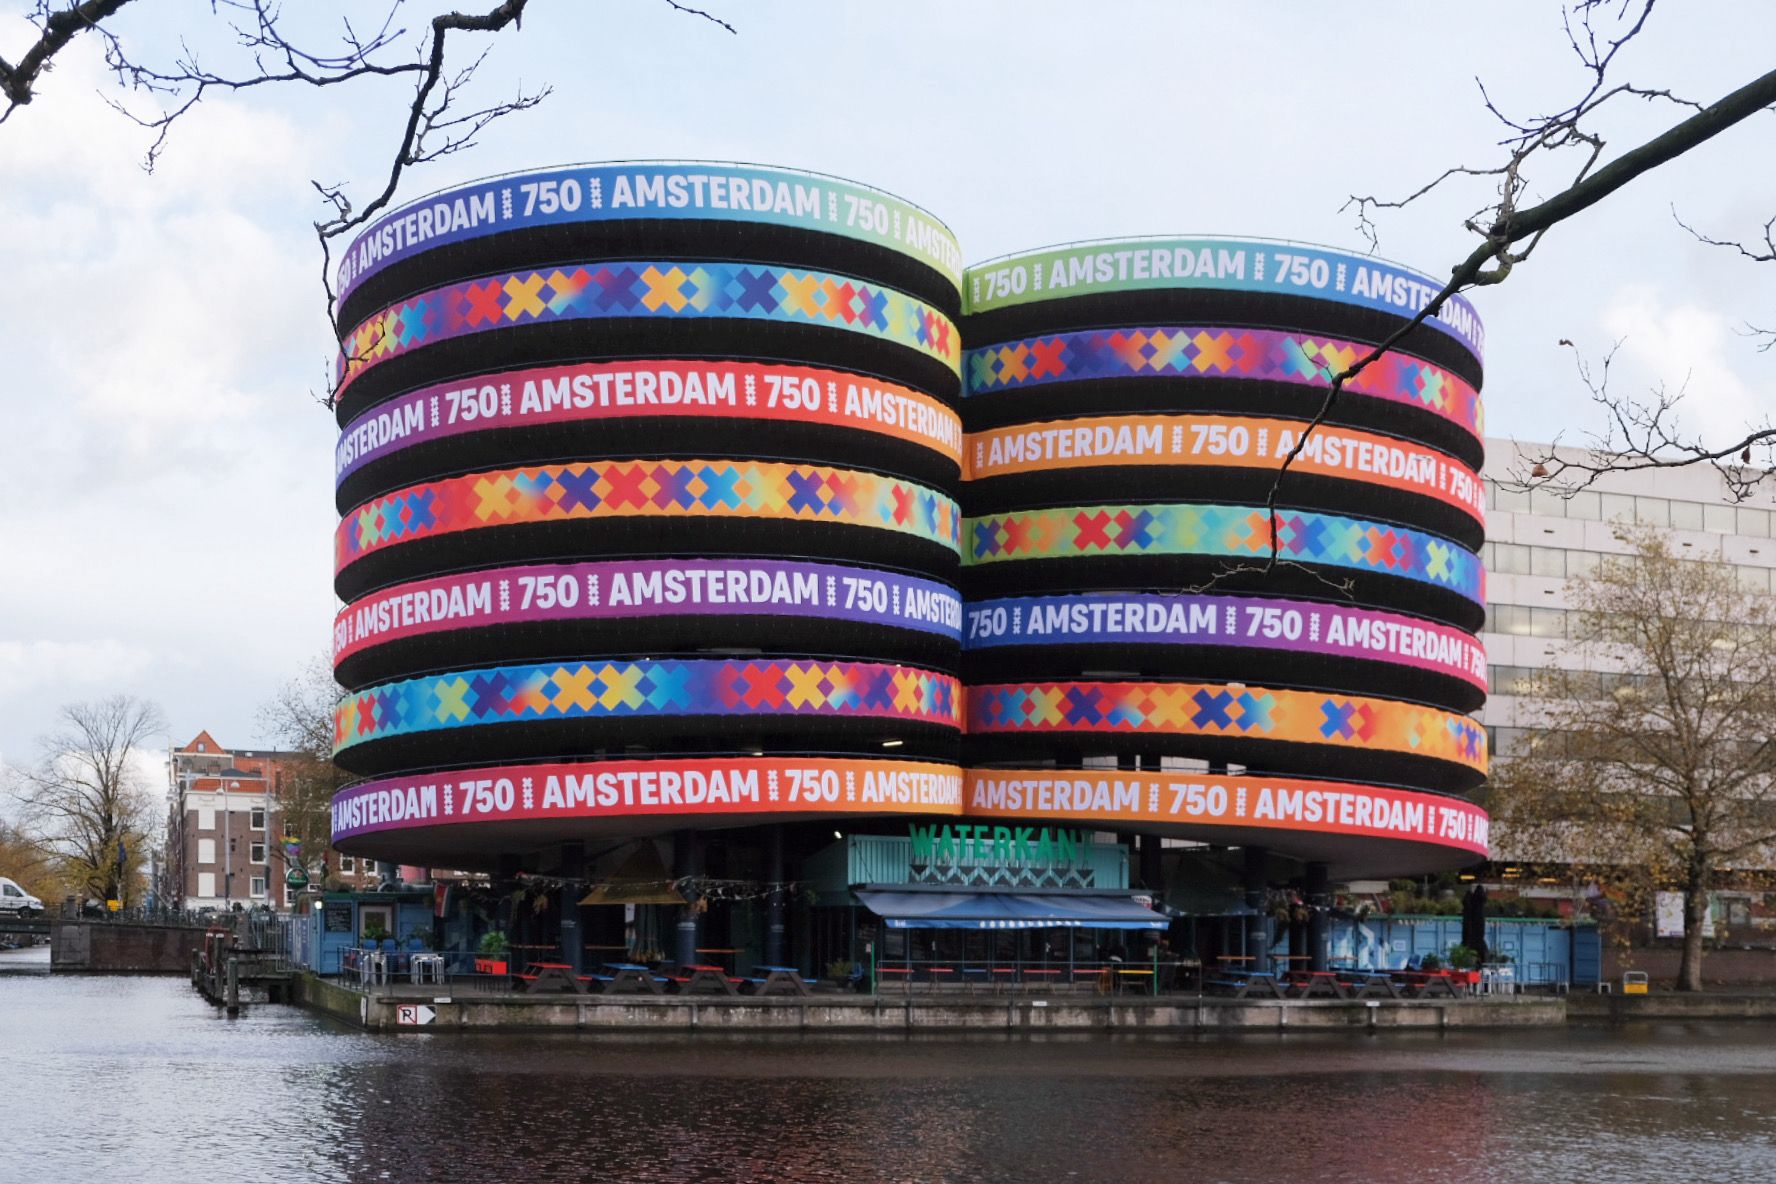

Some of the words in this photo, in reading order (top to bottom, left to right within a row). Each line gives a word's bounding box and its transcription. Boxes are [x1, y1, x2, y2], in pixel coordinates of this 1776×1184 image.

[359, 191, 496, 274] AMSTERDAM
[521, 179, 582, 216] 750
[611, 175, 821, 219] AMSTERDAM
[844, 194, 889, 236] 750
[984, 266, 1028, 301] 750
[1049, 248, 1246, 289] AMSTERDAM
[1274, 254, 1330, 289] 750
[445, 385, 498, 424] 750
[519, 371, 736, 414] AMSTERDAM
[764, 374, 820, 411] 750
[844, 384, 954, 448] AMSTERDAM
[988, 425, 1163, 466] AMSTERDAM
[1190, 425, 1249, 456] 750
[1274, 430, 1436, 487] AMSTERDAM
[1450, 466, 1472, 504] 750
[355, 582, 492, 642] AMSTERDAM
[518, 574, 580, 610] 750
[608, 569, 819, 606] AMSTERDAM
[842, 576, 888, 612] 750
[968, 607, 1007, 640] 750
[1027, 603, 1217, 635] AMSTERDAM
[1245, 606, 1303, 640] 750
[1326, 615, 1462, 669] AMSTERDAM
[337, 785, 437, 832] AMSTERDAM
[459, 778, 515, 814] 750
[542, 770, 759, 809] AMSTERDAM
[785, 769, 839, 802] 750
[861, 771, 957, 804] AMSTERDAM
[972, 778, 1140, 812] AMSTERDAM
[1169, 784, 1228, 816] 750
[1254, 788, 1424, 833] AMSTERDAM
[1439, 806, 1466, 841] 750
